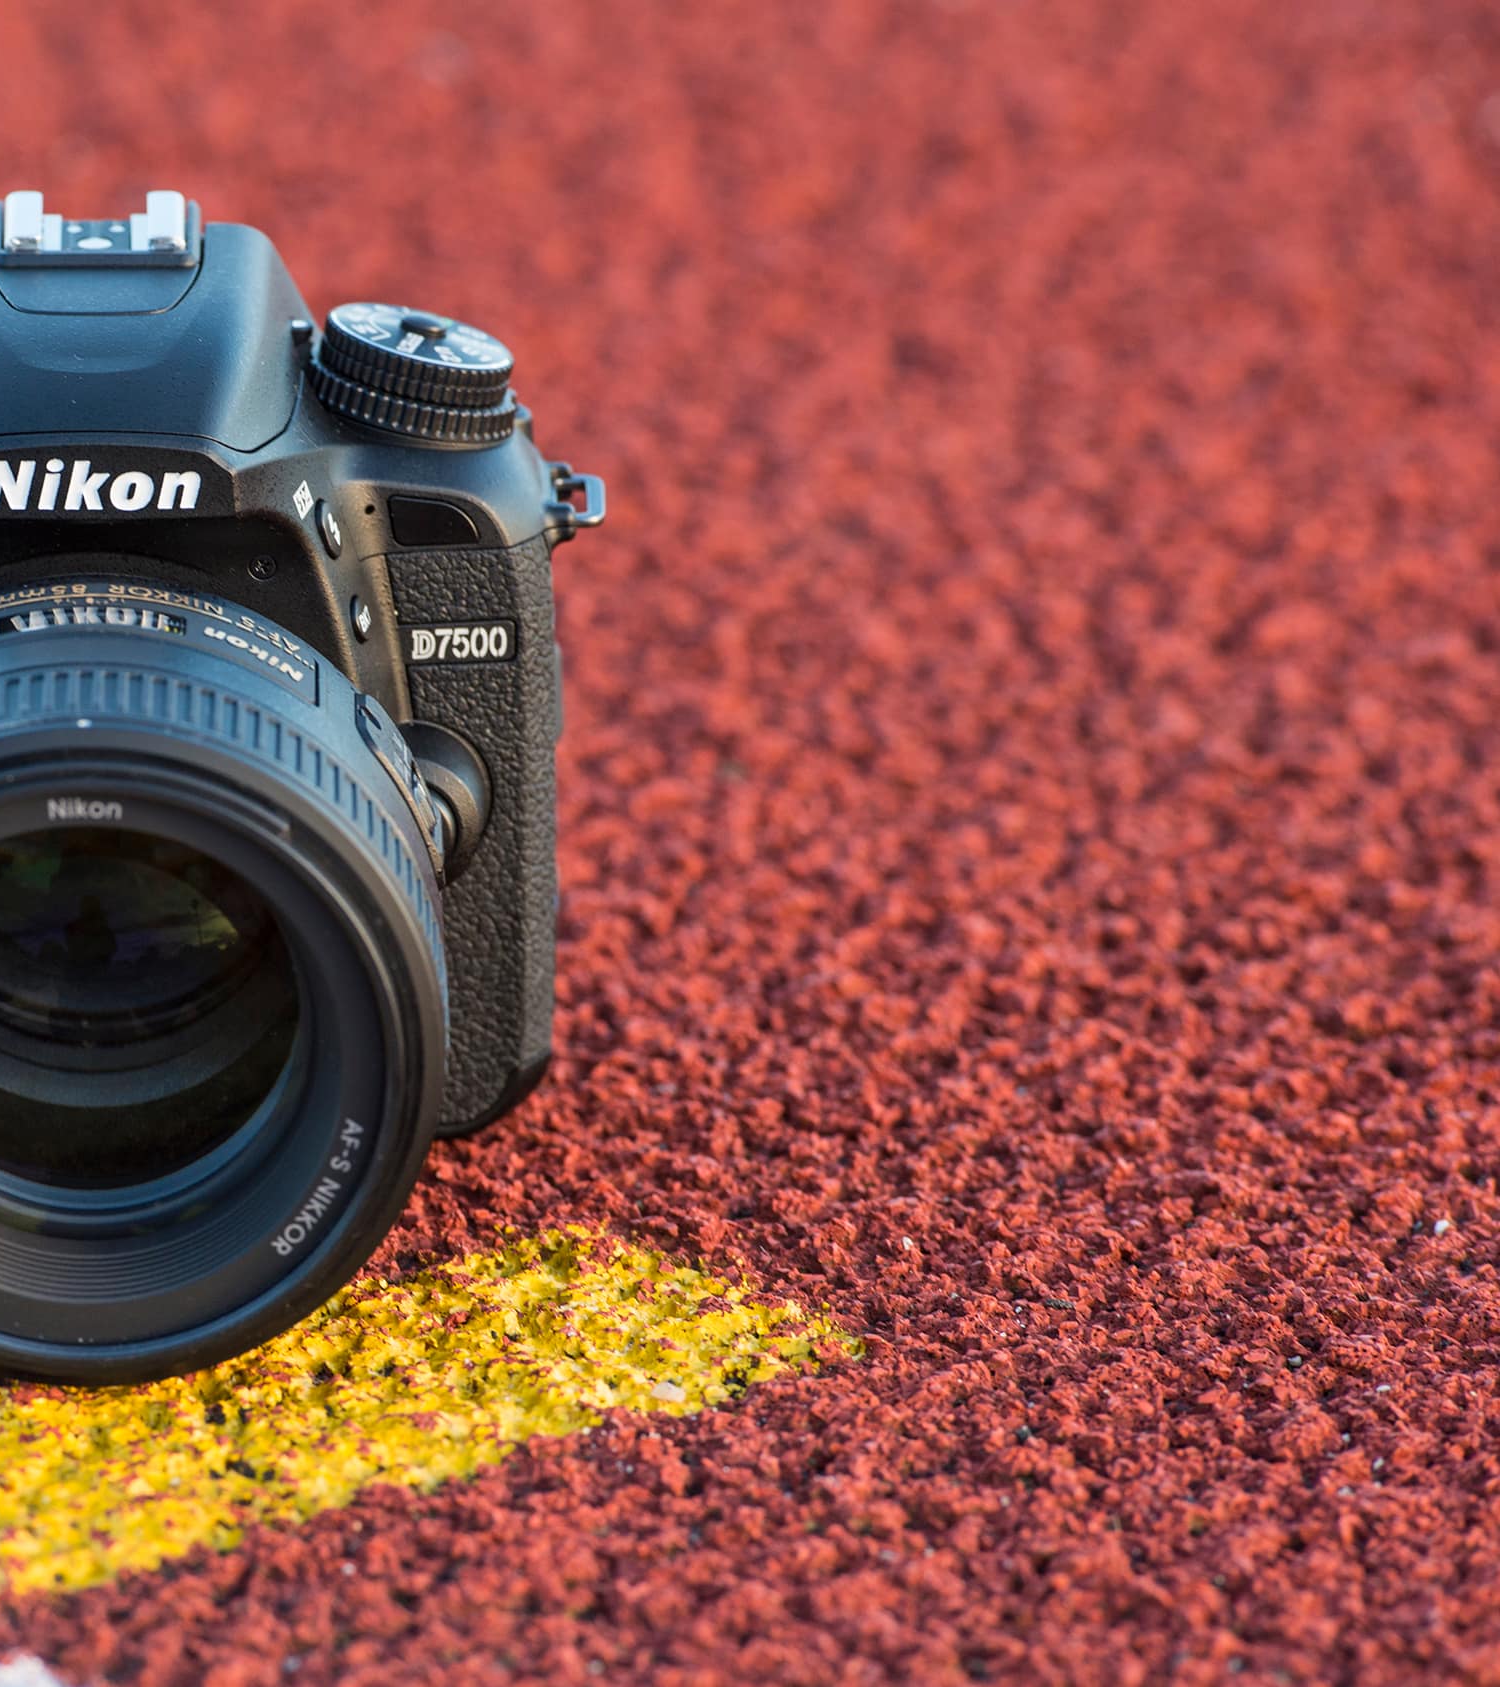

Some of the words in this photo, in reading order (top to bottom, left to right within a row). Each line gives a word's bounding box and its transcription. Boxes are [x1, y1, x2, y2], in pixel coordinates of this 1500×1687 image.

[107, 583, 225, 617] NIKKOR
[203, 626, 304, 683] Nikon
[411, 626, 509, 660] D7500
[47, 796, 123, 821] Nikon
[329, 1117, 370, 1173] AF-S
[270, 1176, 342, 1256] NIKKOR
